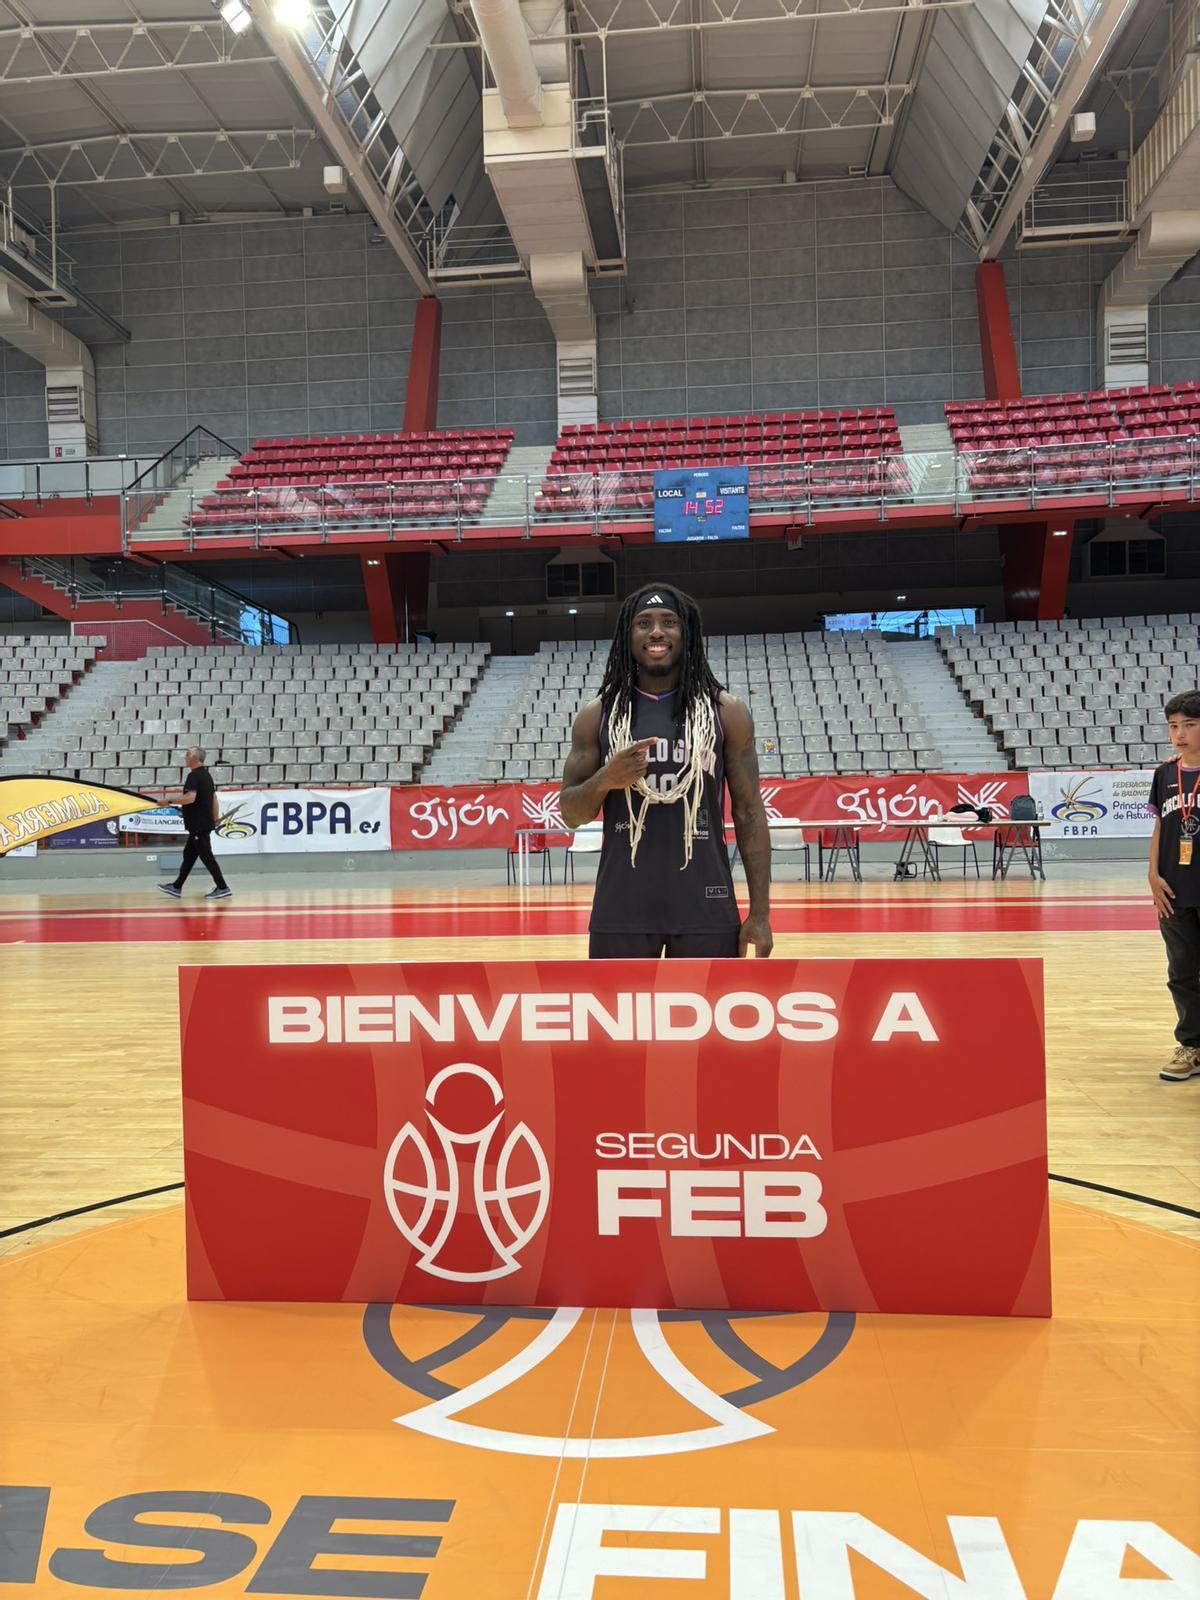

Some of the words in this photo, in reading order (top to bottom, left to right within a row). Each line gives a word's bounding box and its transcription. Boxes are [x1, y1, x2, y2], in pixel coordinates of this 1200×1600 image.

[658, 490, 683, 498] LOCAL
[720, 486, 745, 495] VISITANTE
[260, 801, 381, 836] FBPA.es
[409, 793, 509, 840] gijón
[836, 784, 940, 832] gijón
[268, 991, 839, 1044] BIENVENIDOS
[871, 992, 940, 1042] A
[595, 1132, 823, 1161] SEGUNDA
[597, 1169, 828, 1238] FEB
